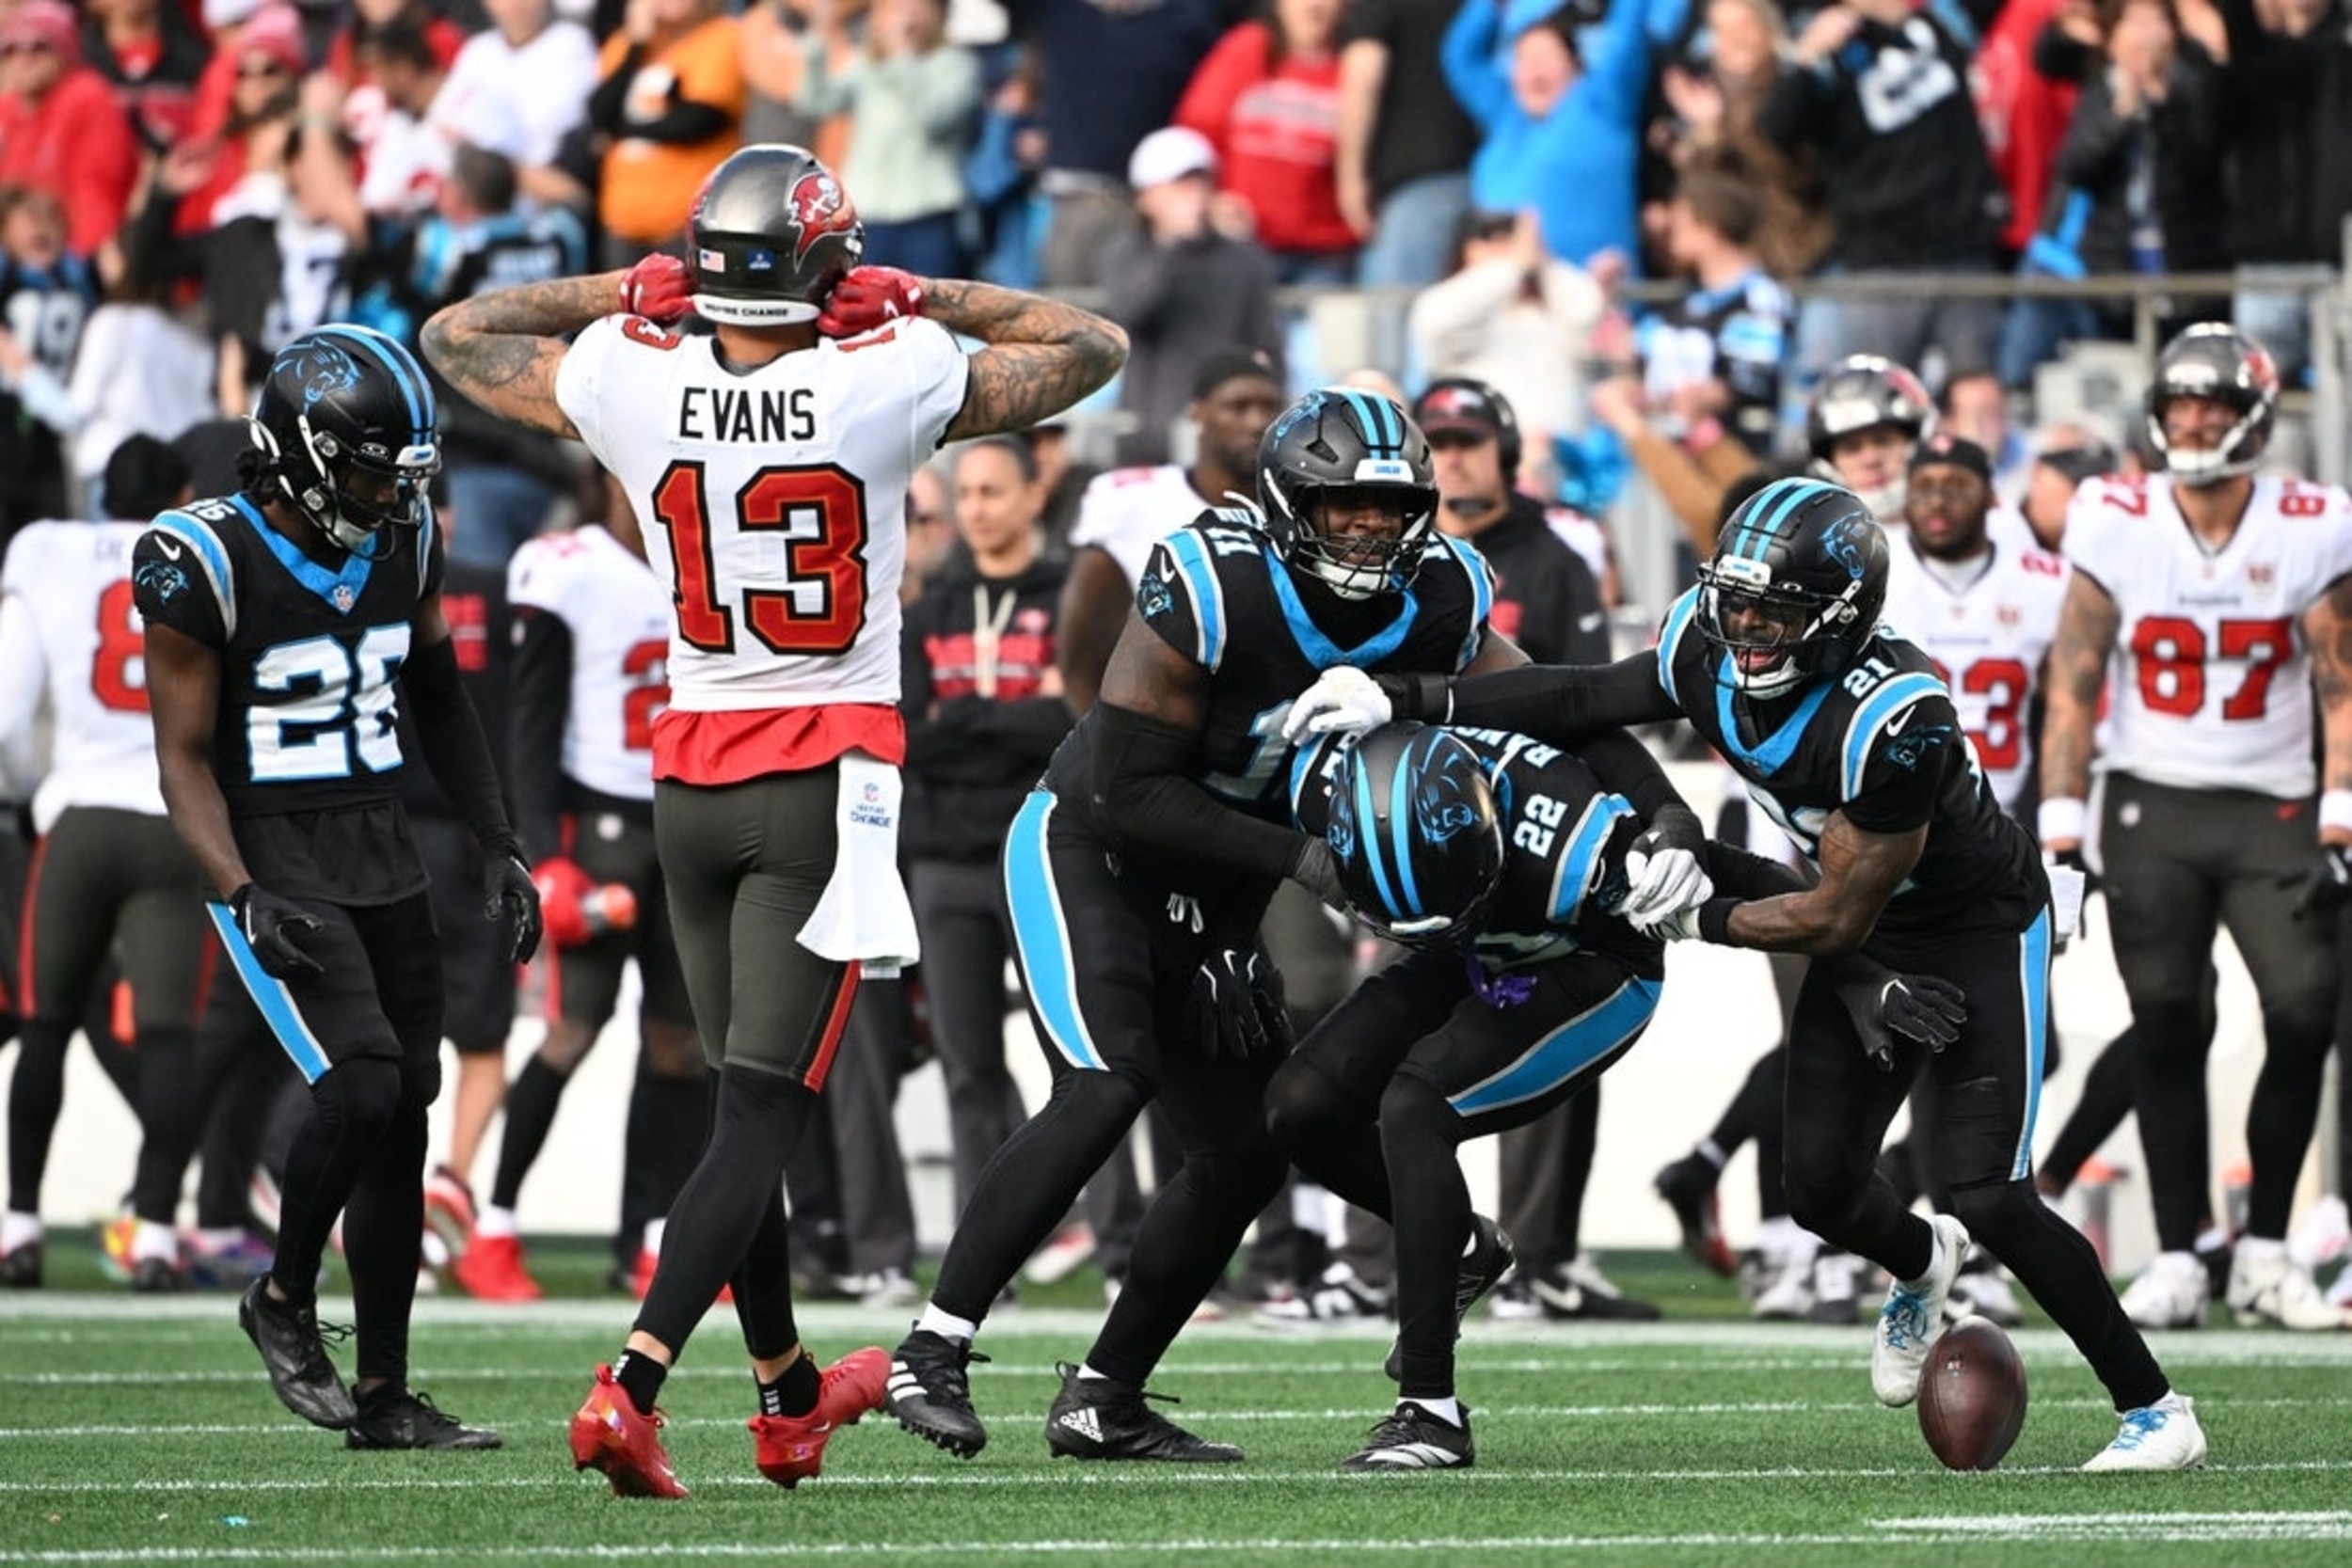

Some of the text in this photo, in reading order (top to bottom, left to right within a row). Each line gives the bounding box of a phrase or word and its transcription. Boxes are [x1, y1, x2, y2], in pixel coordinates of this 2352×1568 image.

[680, 387, 815, 442] EVANS
[652, 459, 869, 656] 13
[1842, 657, 1896, 699] 21
[2131, 615, 2295, 722] 87
[1931, 657, 2027, 769] 3
[1513, 793, 1569, 858] 22
[1060, 1415, 1104, 1443] adidas
